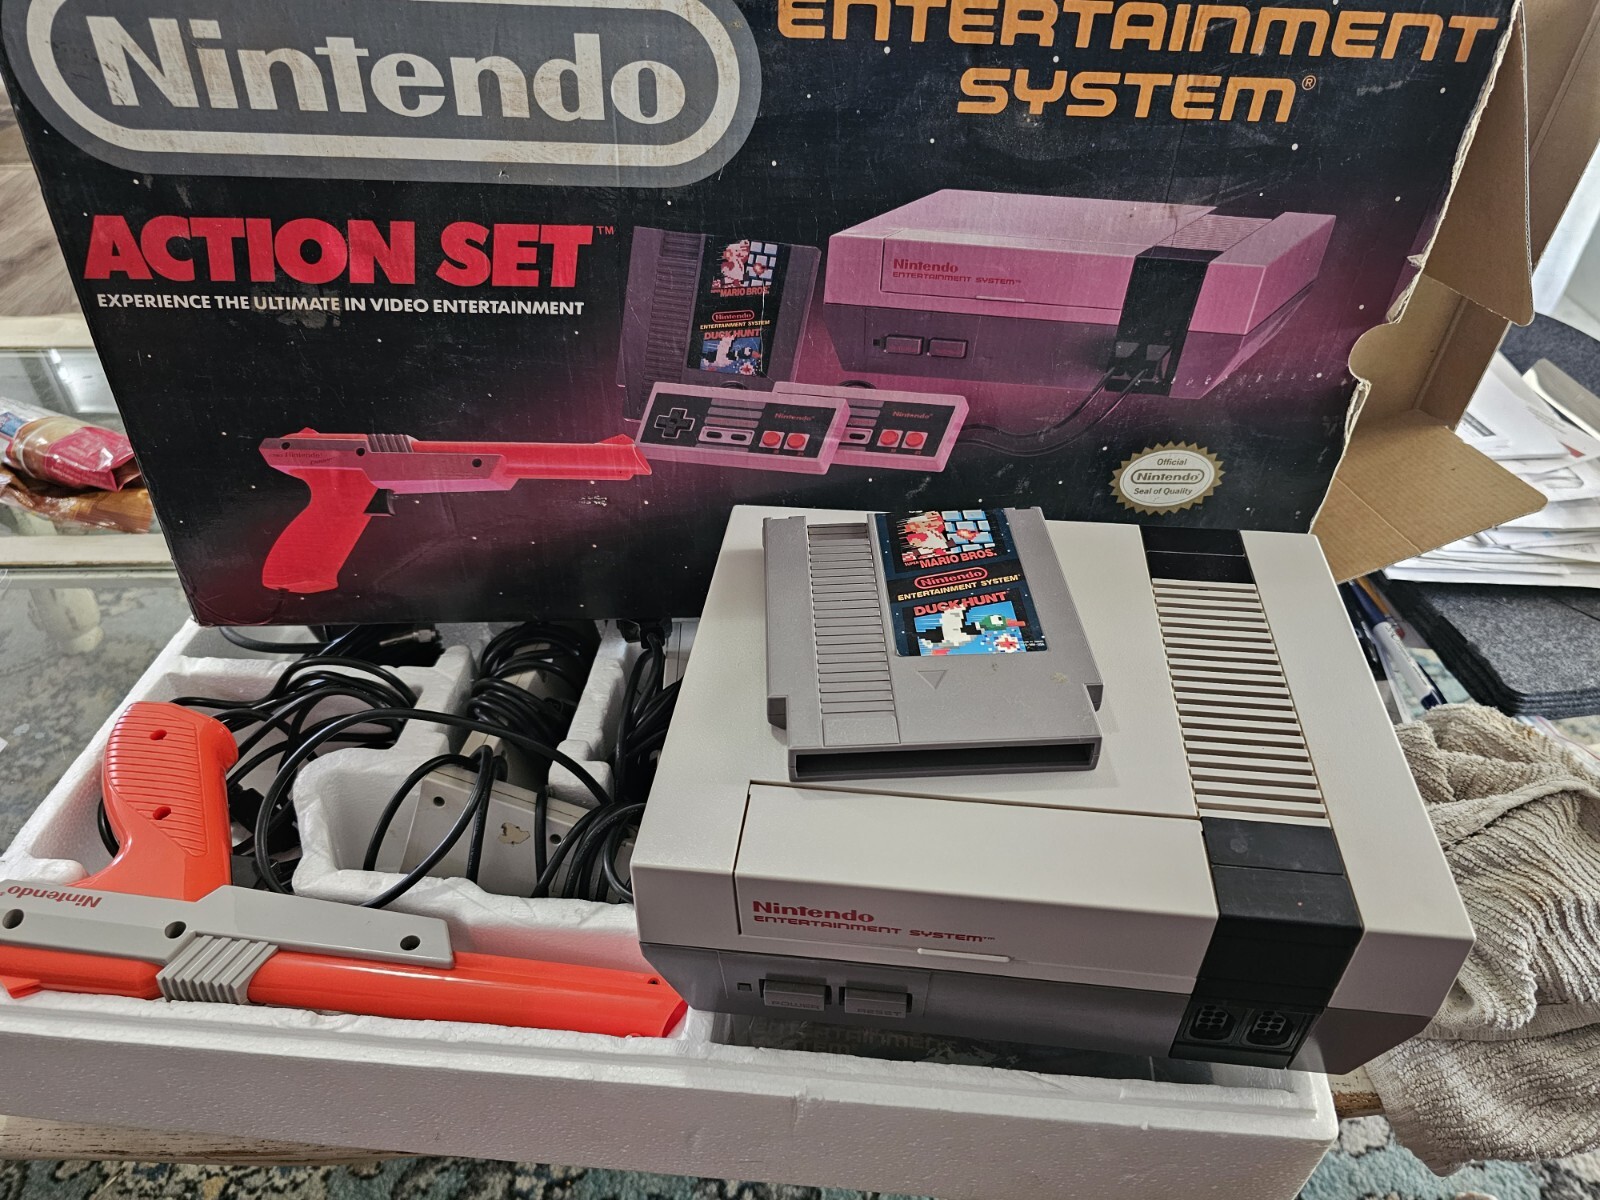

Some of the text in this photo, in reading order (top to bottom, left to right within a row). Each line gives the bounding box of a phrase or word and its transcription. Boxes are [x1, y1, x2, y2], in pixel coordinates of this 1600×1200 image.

[777, 0, 1499, 63] ENTERTAINMENT
[86, 16, 686, 125] Nintendo
[957, 67, 1297, 122] SYSTEM
[84, 214, 416, 285] ACTION
[435, 221, 593, 288] SET
[893, 258, 959, 273] Nintendo
[893, 271, 1014, 285] ENTERTAINMENT SYSTEM
[97, 293, 584, 315] EXPERIENCE THE ULTIMATE IN VIDEO ENTERTAINMENT
[715, 312, 751, 321] Nintendo
[1156, 458, 1188, 466] Official
[1136, 472, 1199, 481] Nintendo
[1133, 487, 1193, 496] Seal of Quality
[919, 554, 960, 569] MARIO
[897, 575, 1019, 601] ENTERTAINMENT SYSTEM
[920, 571, 983, 587] Nintendo
[913, 591, 1008, 616] DUCK HUNT
[7, 885, 102, 908] Nintendo
[753, 900, 875, 923] Nintendo
[754, 915, 902, 935] ENTERTAINMENT
[909, 929, 983, 942] SYSTEM
[771, 1000, 820, 1010] POWER
[856, 1007, 903, 1017] RESET
